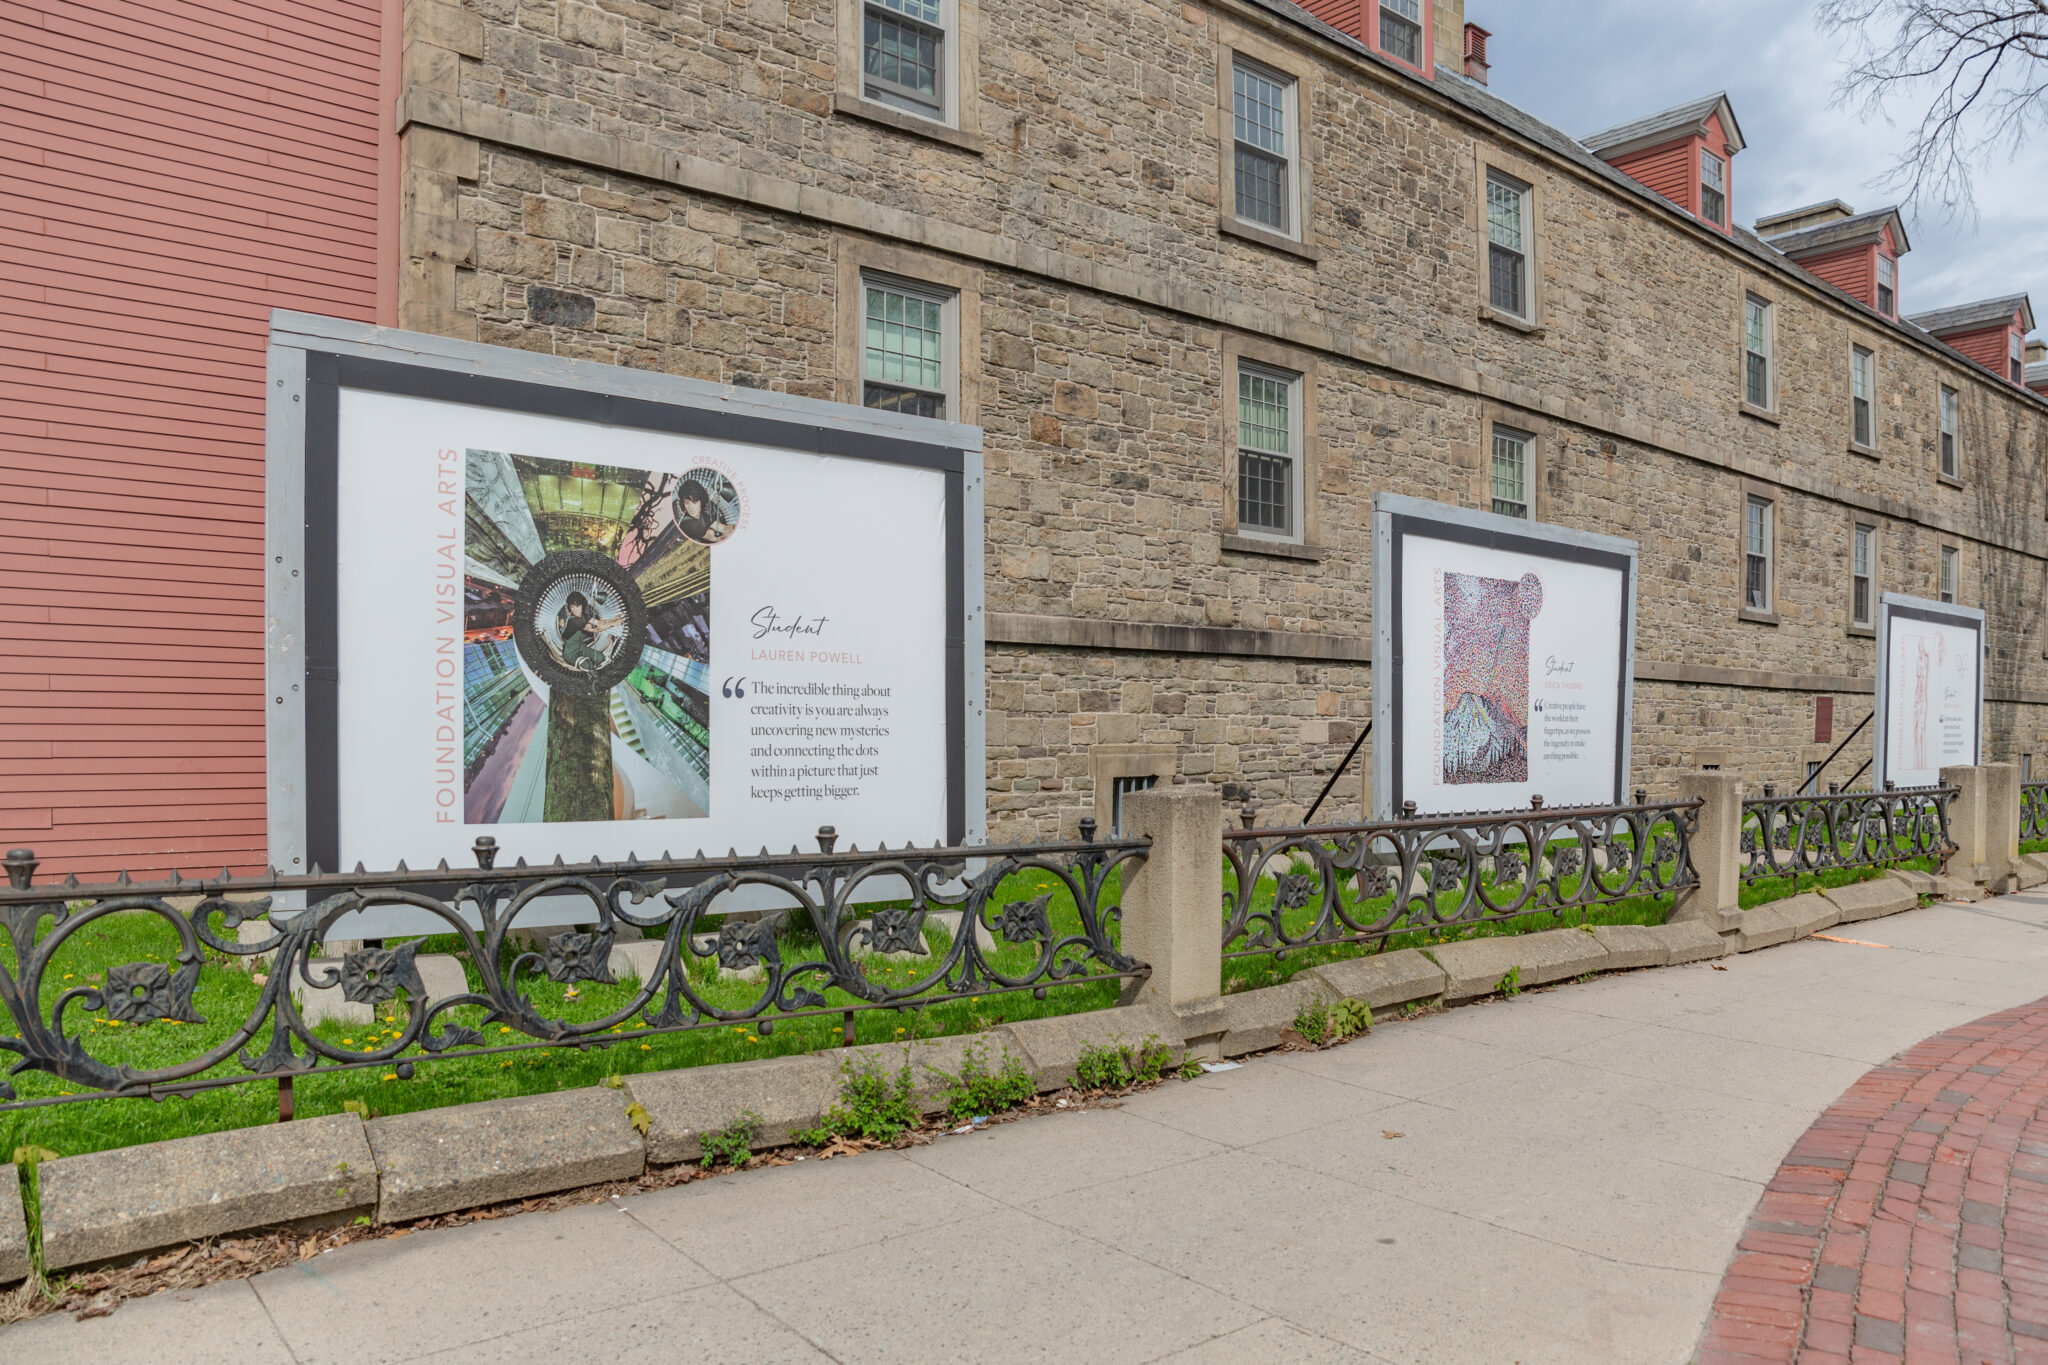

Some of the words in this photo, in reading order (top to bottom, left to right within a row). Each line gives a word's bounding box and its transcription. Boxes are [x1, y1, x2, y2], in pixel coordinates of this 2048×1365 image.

[437, 448, 457, 517] ARTS
[691, 456, 738, 481] CREATIVE
[736, 481, 750, 532] PROCESS
[436, 527, 456, 624] VISUAL
[750, 606, 829, 639] Student
[1433, 615, 1441, 670] VISUAL
[751, 649, 805, 661] LAUREN
[810, 651, 863, 664] POWELL
[751, 681, 775, 695] The
[776, 682, 830, 696] incredible
[832, 683, 860, 700] thing
[861, 684, 891, 697] about
[750, 703, 802, 720] creativity
[805, 704, 814, 716] is
[815, 706, 835, 720] you
[836, 706, 854, 717] are
[854, 704, 889, 720] always
[436, 637, 456, 823] FOUNDATION
[751, 723, 814, 740] uncovering
[815, 726, 838, 737] new
[840, 724, 890, 740] mysteries
[1433, 676, 1441, 786] FOUNDATION
[750, 743, 772, 757] and
[773, 744, 836, 760] connecting
[837, 743, 855, 756] the
[855, 743, 879, 756] dots
[751, 764, 788, 777] within
[789, 767, 796, 777] a
[797, 764, 836, 781] picture
[837, 763, 858, 776] that
[858, 764, 879, 780] just
[751, 785, 783, 802] keeps
[784, 785, 823, 801] getting
[824, 784, 860, 800] bigger.
